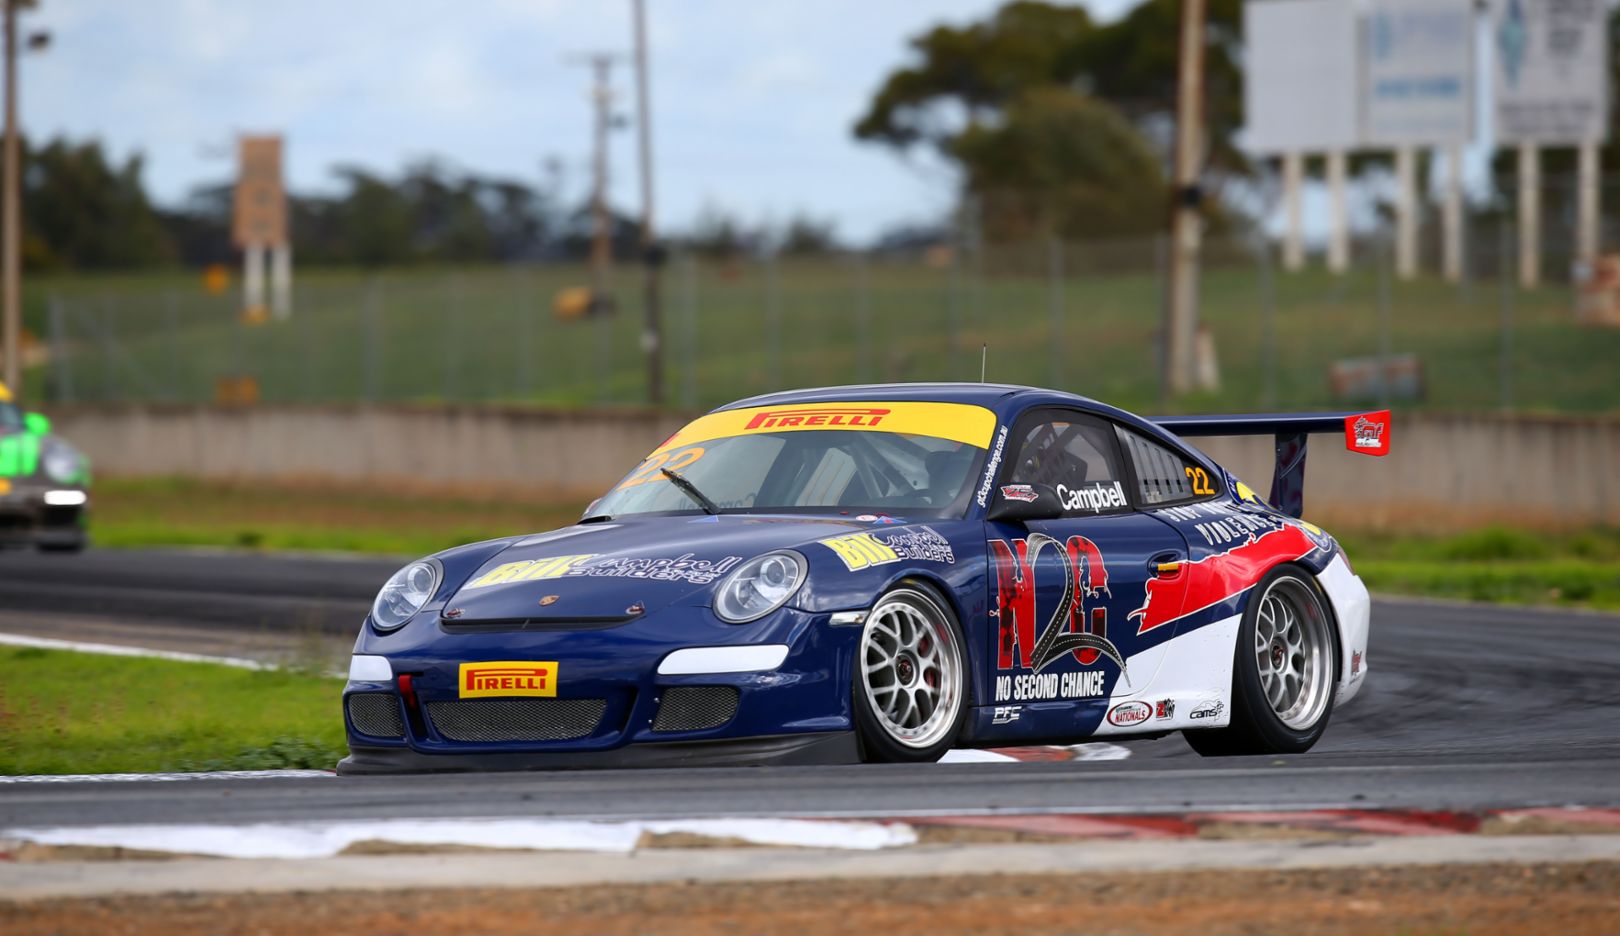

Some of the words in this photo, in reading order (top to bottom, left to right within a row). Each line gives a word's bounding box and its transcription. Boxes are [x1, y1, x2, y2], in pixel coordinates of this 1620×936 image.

[744, 408, 892, 430] PIRELLI
[616, 447, 705, 492] 22
[1185, 467, 1216, 495] 22
[1056, 481, 1128, 513] Campbell
[1195, 513, 1276, 546] VIOLENCE
[893, 546, 955, 564] Builders
[466, 668, 548, 691] PIRELLI
[995, 675, 1011, 702] NO
[1013, 673, 1059, 701] SECOND
[1060, 670, 1105, 698] CHANCE
[994, 705, 1022, 719] PFC
[1115, 709, 1146, 722] NATIONALS
[1189, 707, 1218, 720] cams
